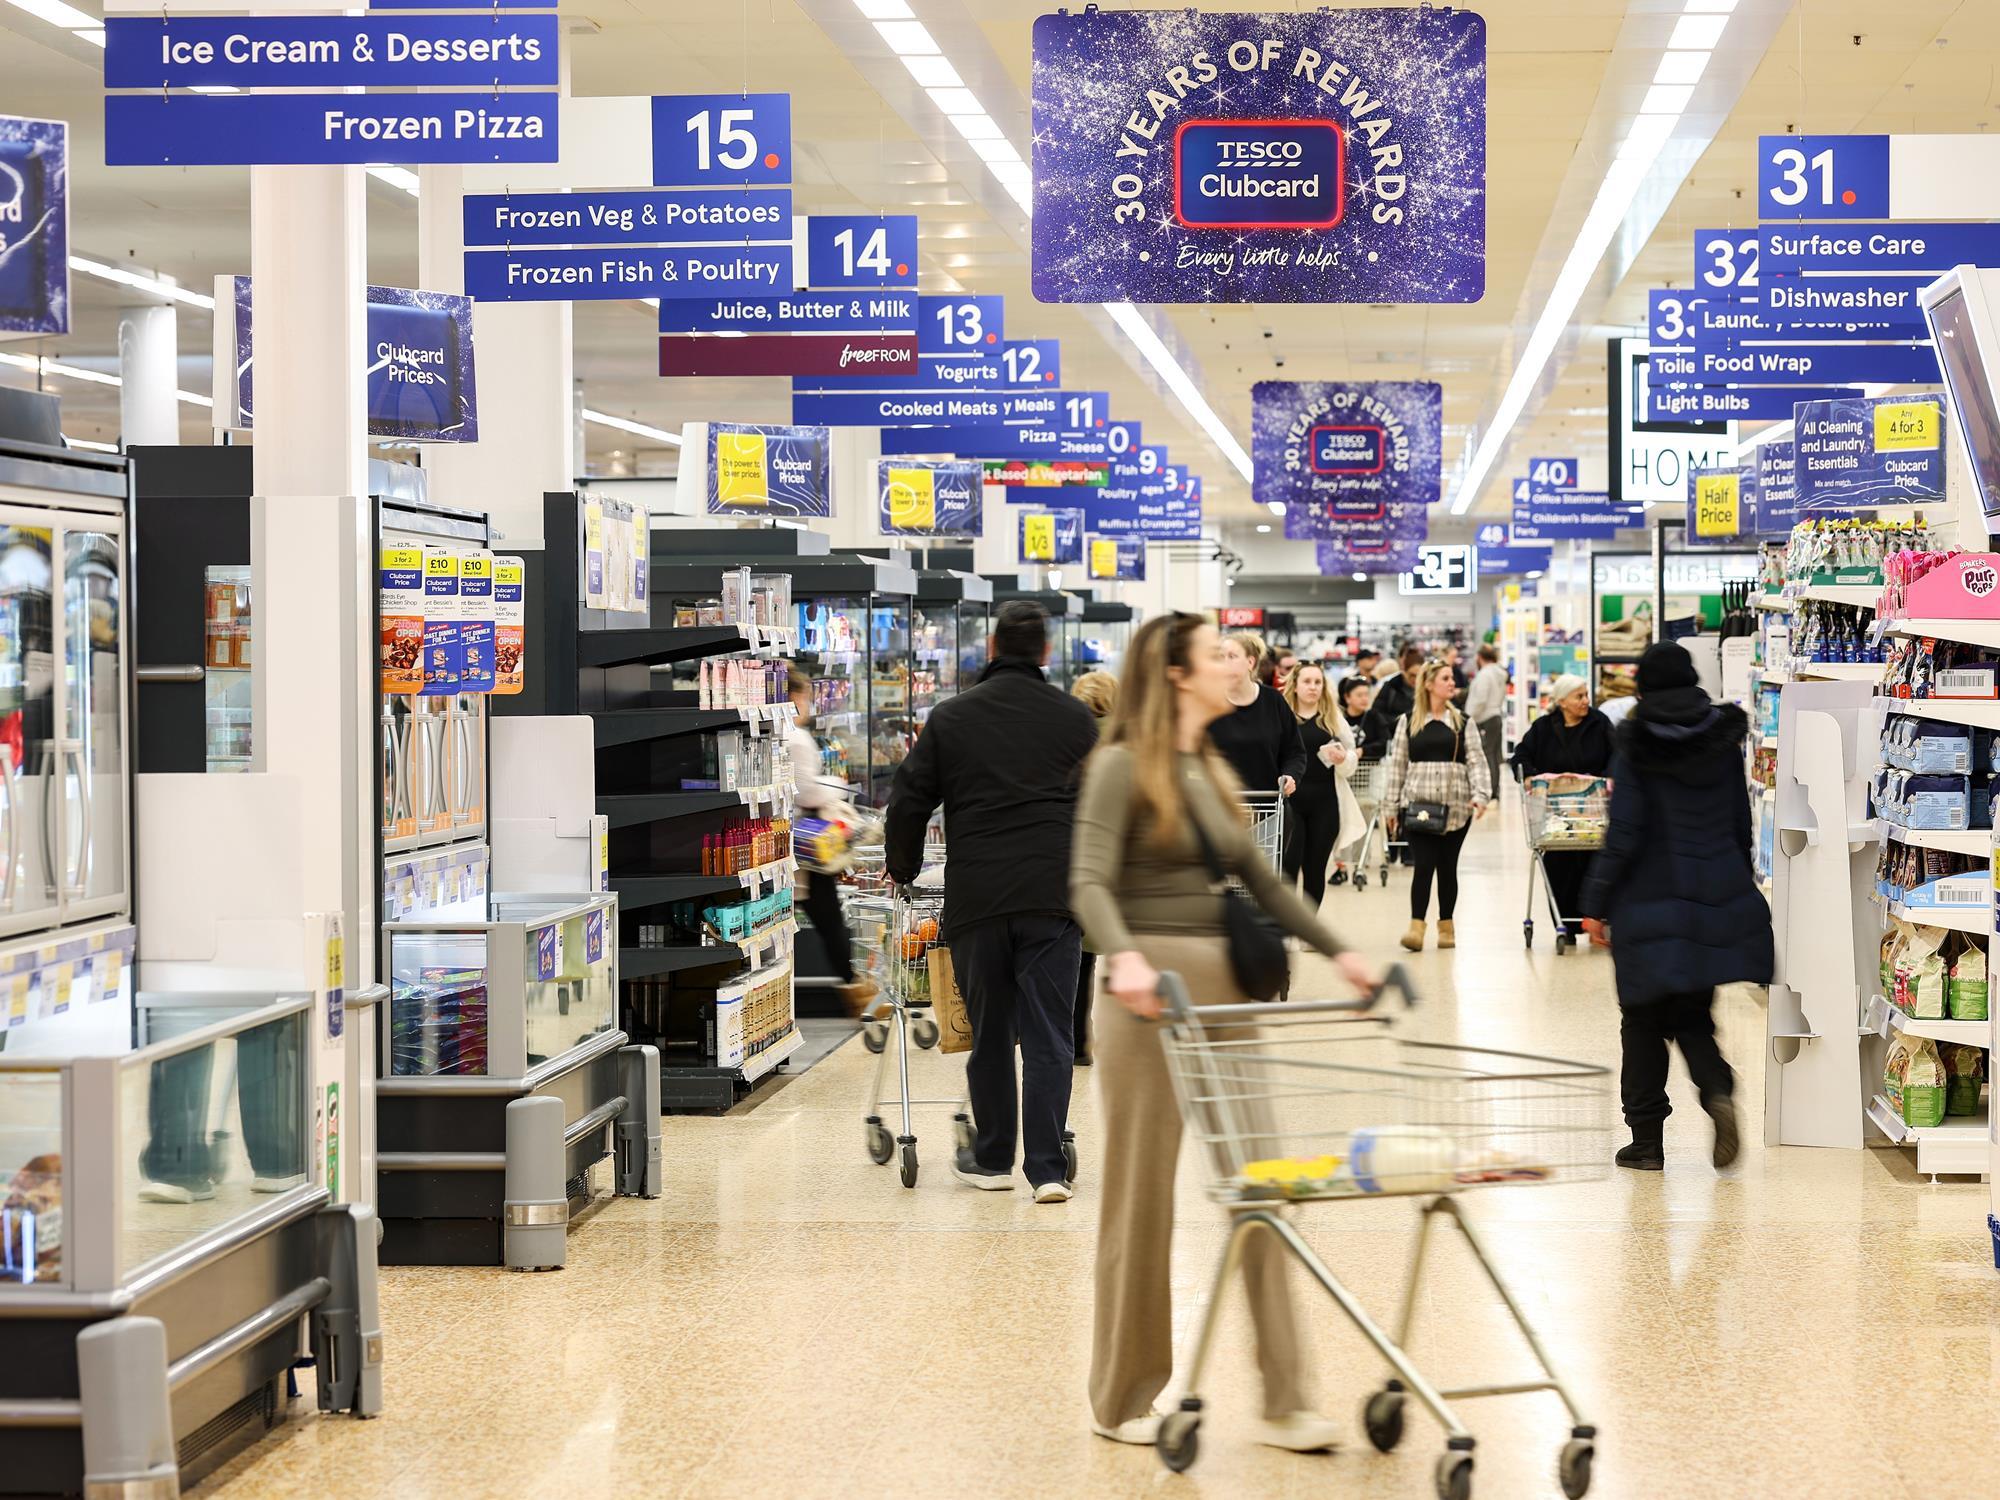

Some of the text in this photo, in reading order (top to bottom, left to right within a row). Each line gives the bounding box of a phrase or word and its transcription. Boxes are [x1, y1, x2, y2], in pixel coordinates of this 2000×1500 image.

[162, 32, 542, 65] Ice Cream & Desserts
[324, 110, 544, 140] Frozen Pizza
[1112, 39, 1407, 225] 30 YEARS OF REWARDS
[1216, 142, 1302, 158] TESCO
[1200, 174, 1319, 197] Clubcard
[496, 202, 780, 231] Frozen Veg & Potatoes
[1769, 234, 1926, 256] Surface Care
[1177, 245, 1340, 275] Every little helps
[508, 258, 780, 285] Frozen Fish & Poultry
[1770, 287, 1909, 309] Dishwasher
[711, 300, 910, 321] Juice, Butter & Milk
[377, 342, 444, 364] Clubcard
[839, 345, 910, 367] freeFROM
[1656, 359, 1695, 374] Toile
[1704, 355, 1812, 375] Food Wrap
[388, 365, 434, 385] Prices
[934, 364, 998, 383] Yogurts
[879, 401, 943, 417] Cooked
[948, 400, 998, 416] Meats
[1014, 398, 1056, 412] Meals
[1656, 395, 1750, 413] Light Bulbs
[1901, 410, 1913, 419] Any
[1286, 398, 1331, 444] YEARS
[1333, 393, 1358, 408] OF
[1361, 396, 1410, 472] REWARDS
[1803, 420, 1863, 436] All Cleaning
[1890, 420, 1924, 434] 4 for 3
[1019, 429, 1056, 443] Pizza
[1801, 438, 1865, 453] and Laundry
[1321, 449, 1374, 460] Clubcard
[773, 459, 812, 471] Clubcard
[1761, 461, 1771, 472] All
[1808, 456, 1858, 470] Essentials
[1885, 459, 1928, 473] Clubcard
[741, 470, 760, 479] prices
[779, 472, 806, 484] Prices
[993, 467, 1028, 481] Based
[1040, 467, 1103, 482] Vegetarian
[1760, 476, 1775, 487] and
[1894, 475, 1920, 487] Price
[1814, 480, 1824, 488] Mix
[1835, 479, 1851, 487] match
[1532, 494, 1561, 504] Office
[1705, 488, 1729, 504] Half
[1765, 490, 1795, 501] Essenti
[1581, 514, 1629, 525] Stationery
[1701, 508, 1732, 523] Price
[1031, 536, 1048, 550] 1/3
[430, 559, 448, 569] £10
[464, 561, 482, 571] £10
[395, 629, 422, 638] OPEN
